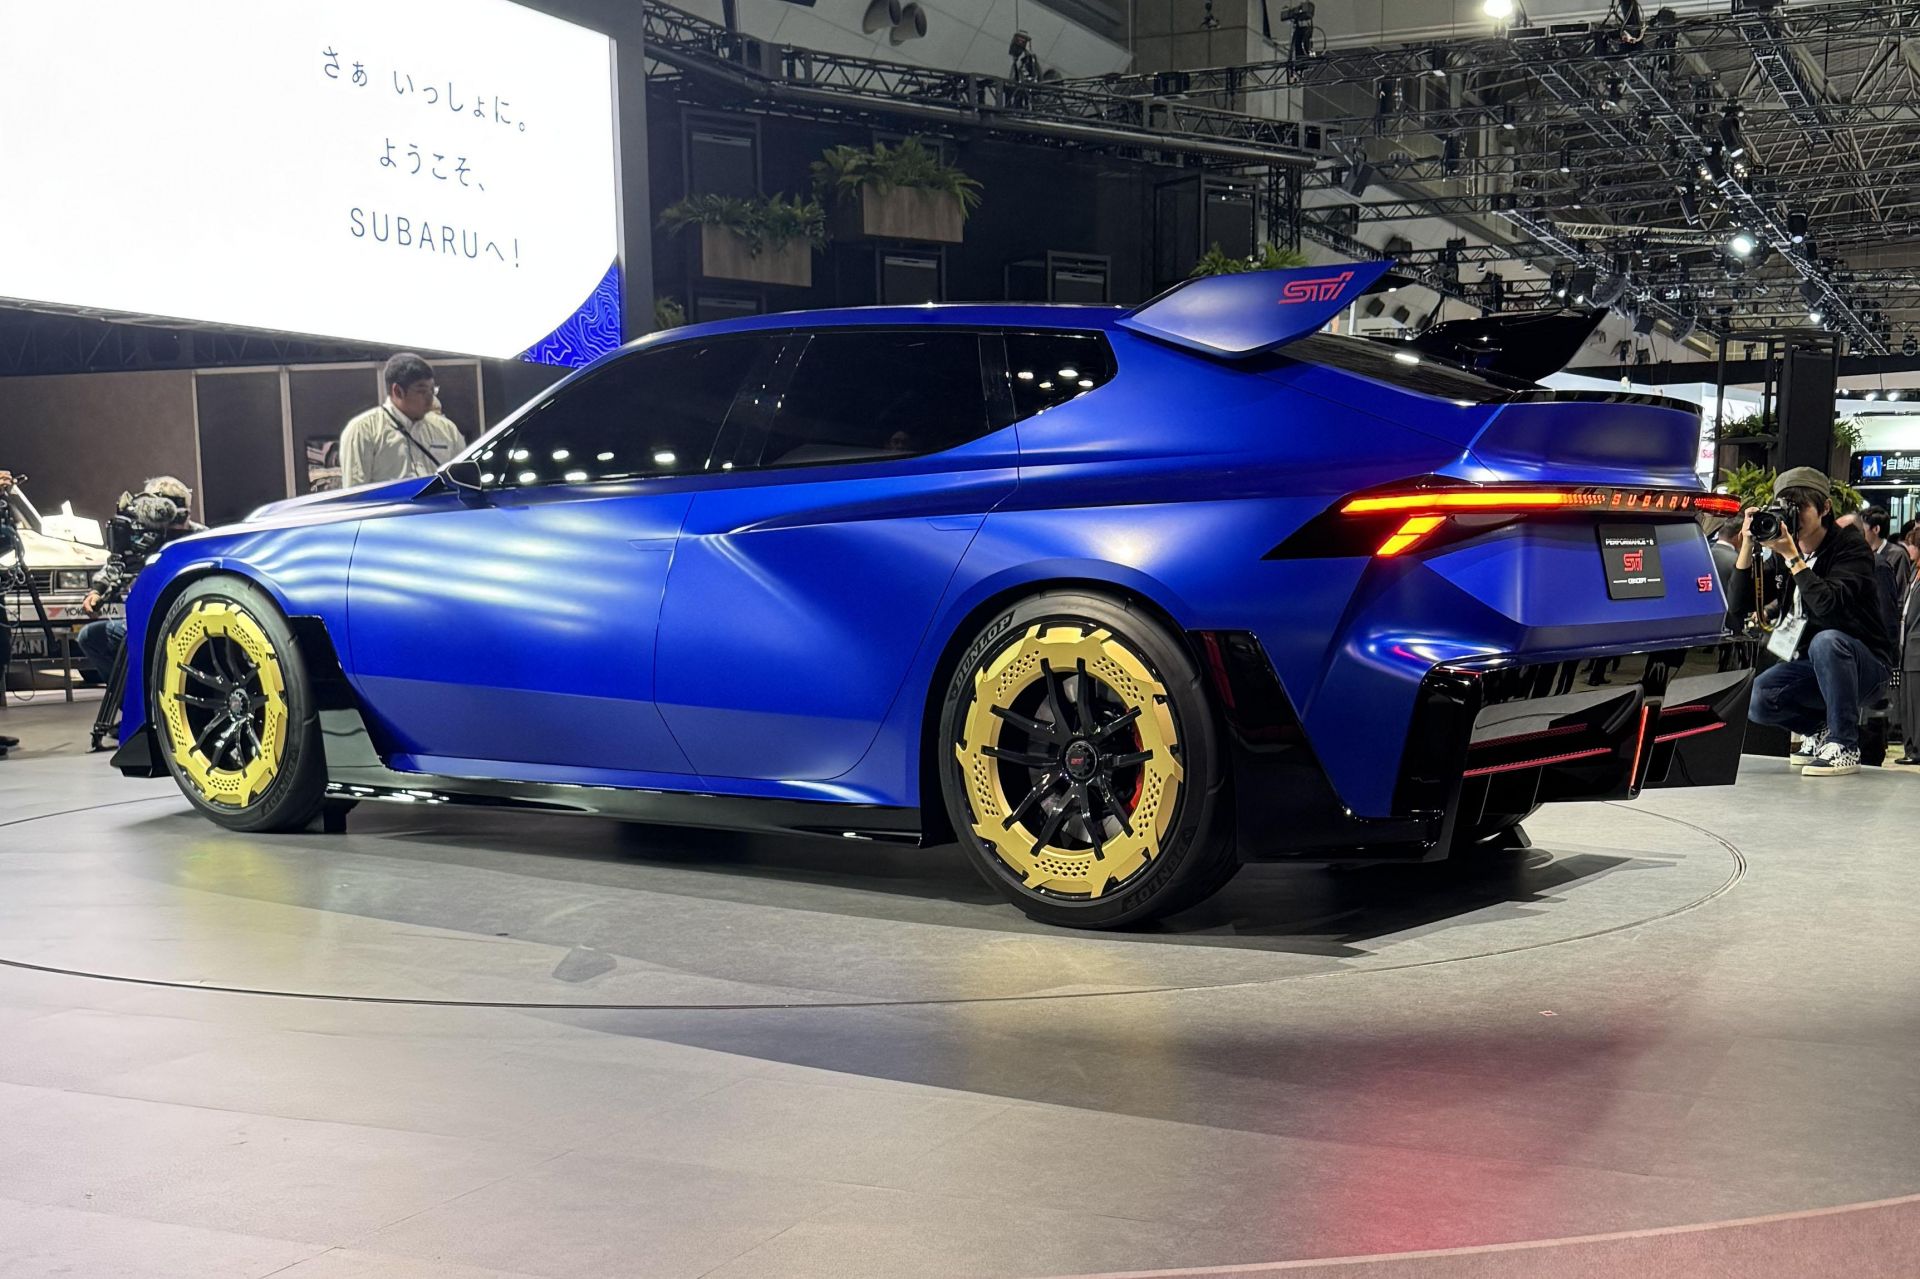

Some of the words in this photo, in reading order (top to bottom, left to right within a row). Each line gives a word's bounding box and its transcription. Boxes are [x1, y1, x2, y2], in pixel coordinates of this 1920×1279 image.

[394, 70, 526, 132] いっしょに。
[380, 138, 485, 191] ようこそ、
[1611, 493, 1691, 509] SUBARU
[955, 615, 1011, 689] DUNLOP
